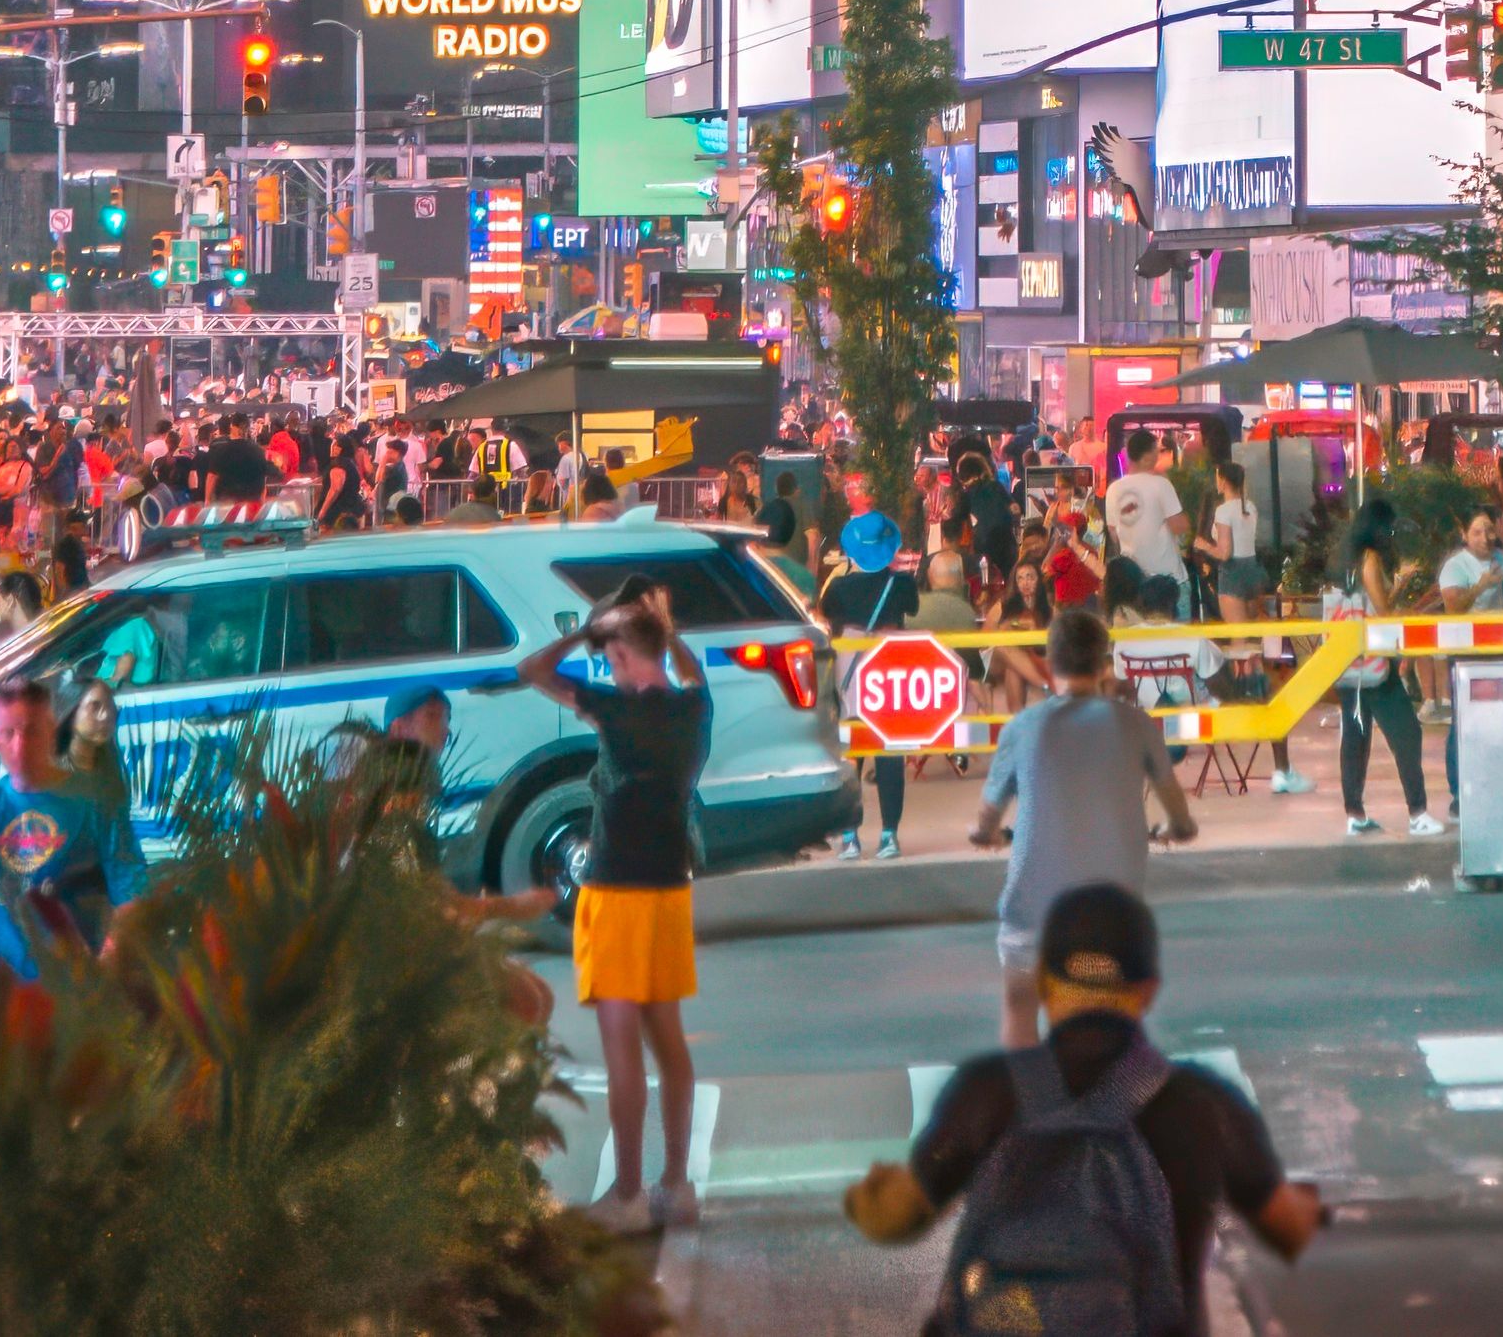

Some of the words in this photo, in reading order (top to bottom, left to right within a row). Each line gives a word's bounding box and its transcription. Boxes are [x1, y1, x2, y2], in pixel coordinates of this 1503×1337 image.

[436, 26, 548, 58] RADIO
[1264, 39, 1284, 61] W
[1299, 38, 1325, 61] 47
[1339, 37, 1362, 61] St
[553, 228, 589, 248] EPT
[349, 276, 373, 292] 25
[1021, 261, 1058, 298] SEPHORA
[863, 668, 956, 713] STOP
